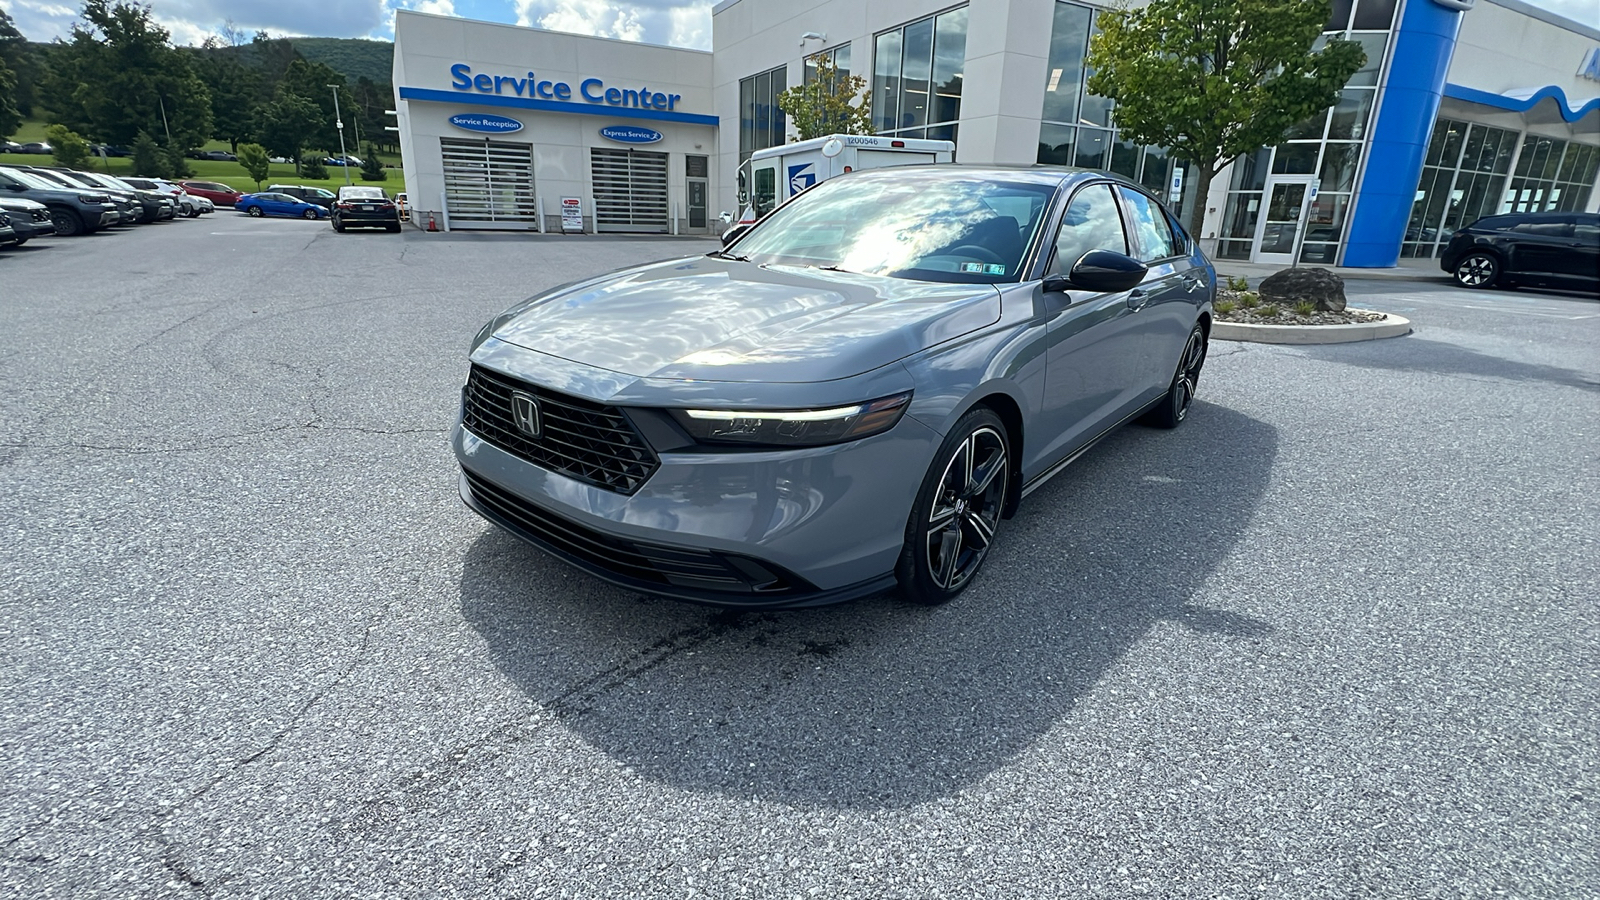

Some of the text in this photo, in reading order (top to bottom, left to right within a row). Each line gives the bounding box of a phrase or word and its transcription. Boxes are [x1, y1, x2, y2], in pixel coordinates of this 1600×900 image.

[450, 63, 681, 111] Service Center
[453, 116, 519, 129] Service Reception
[603, 129, 650, 140] Express Service
[847, 136, 879, 145] 1200546
